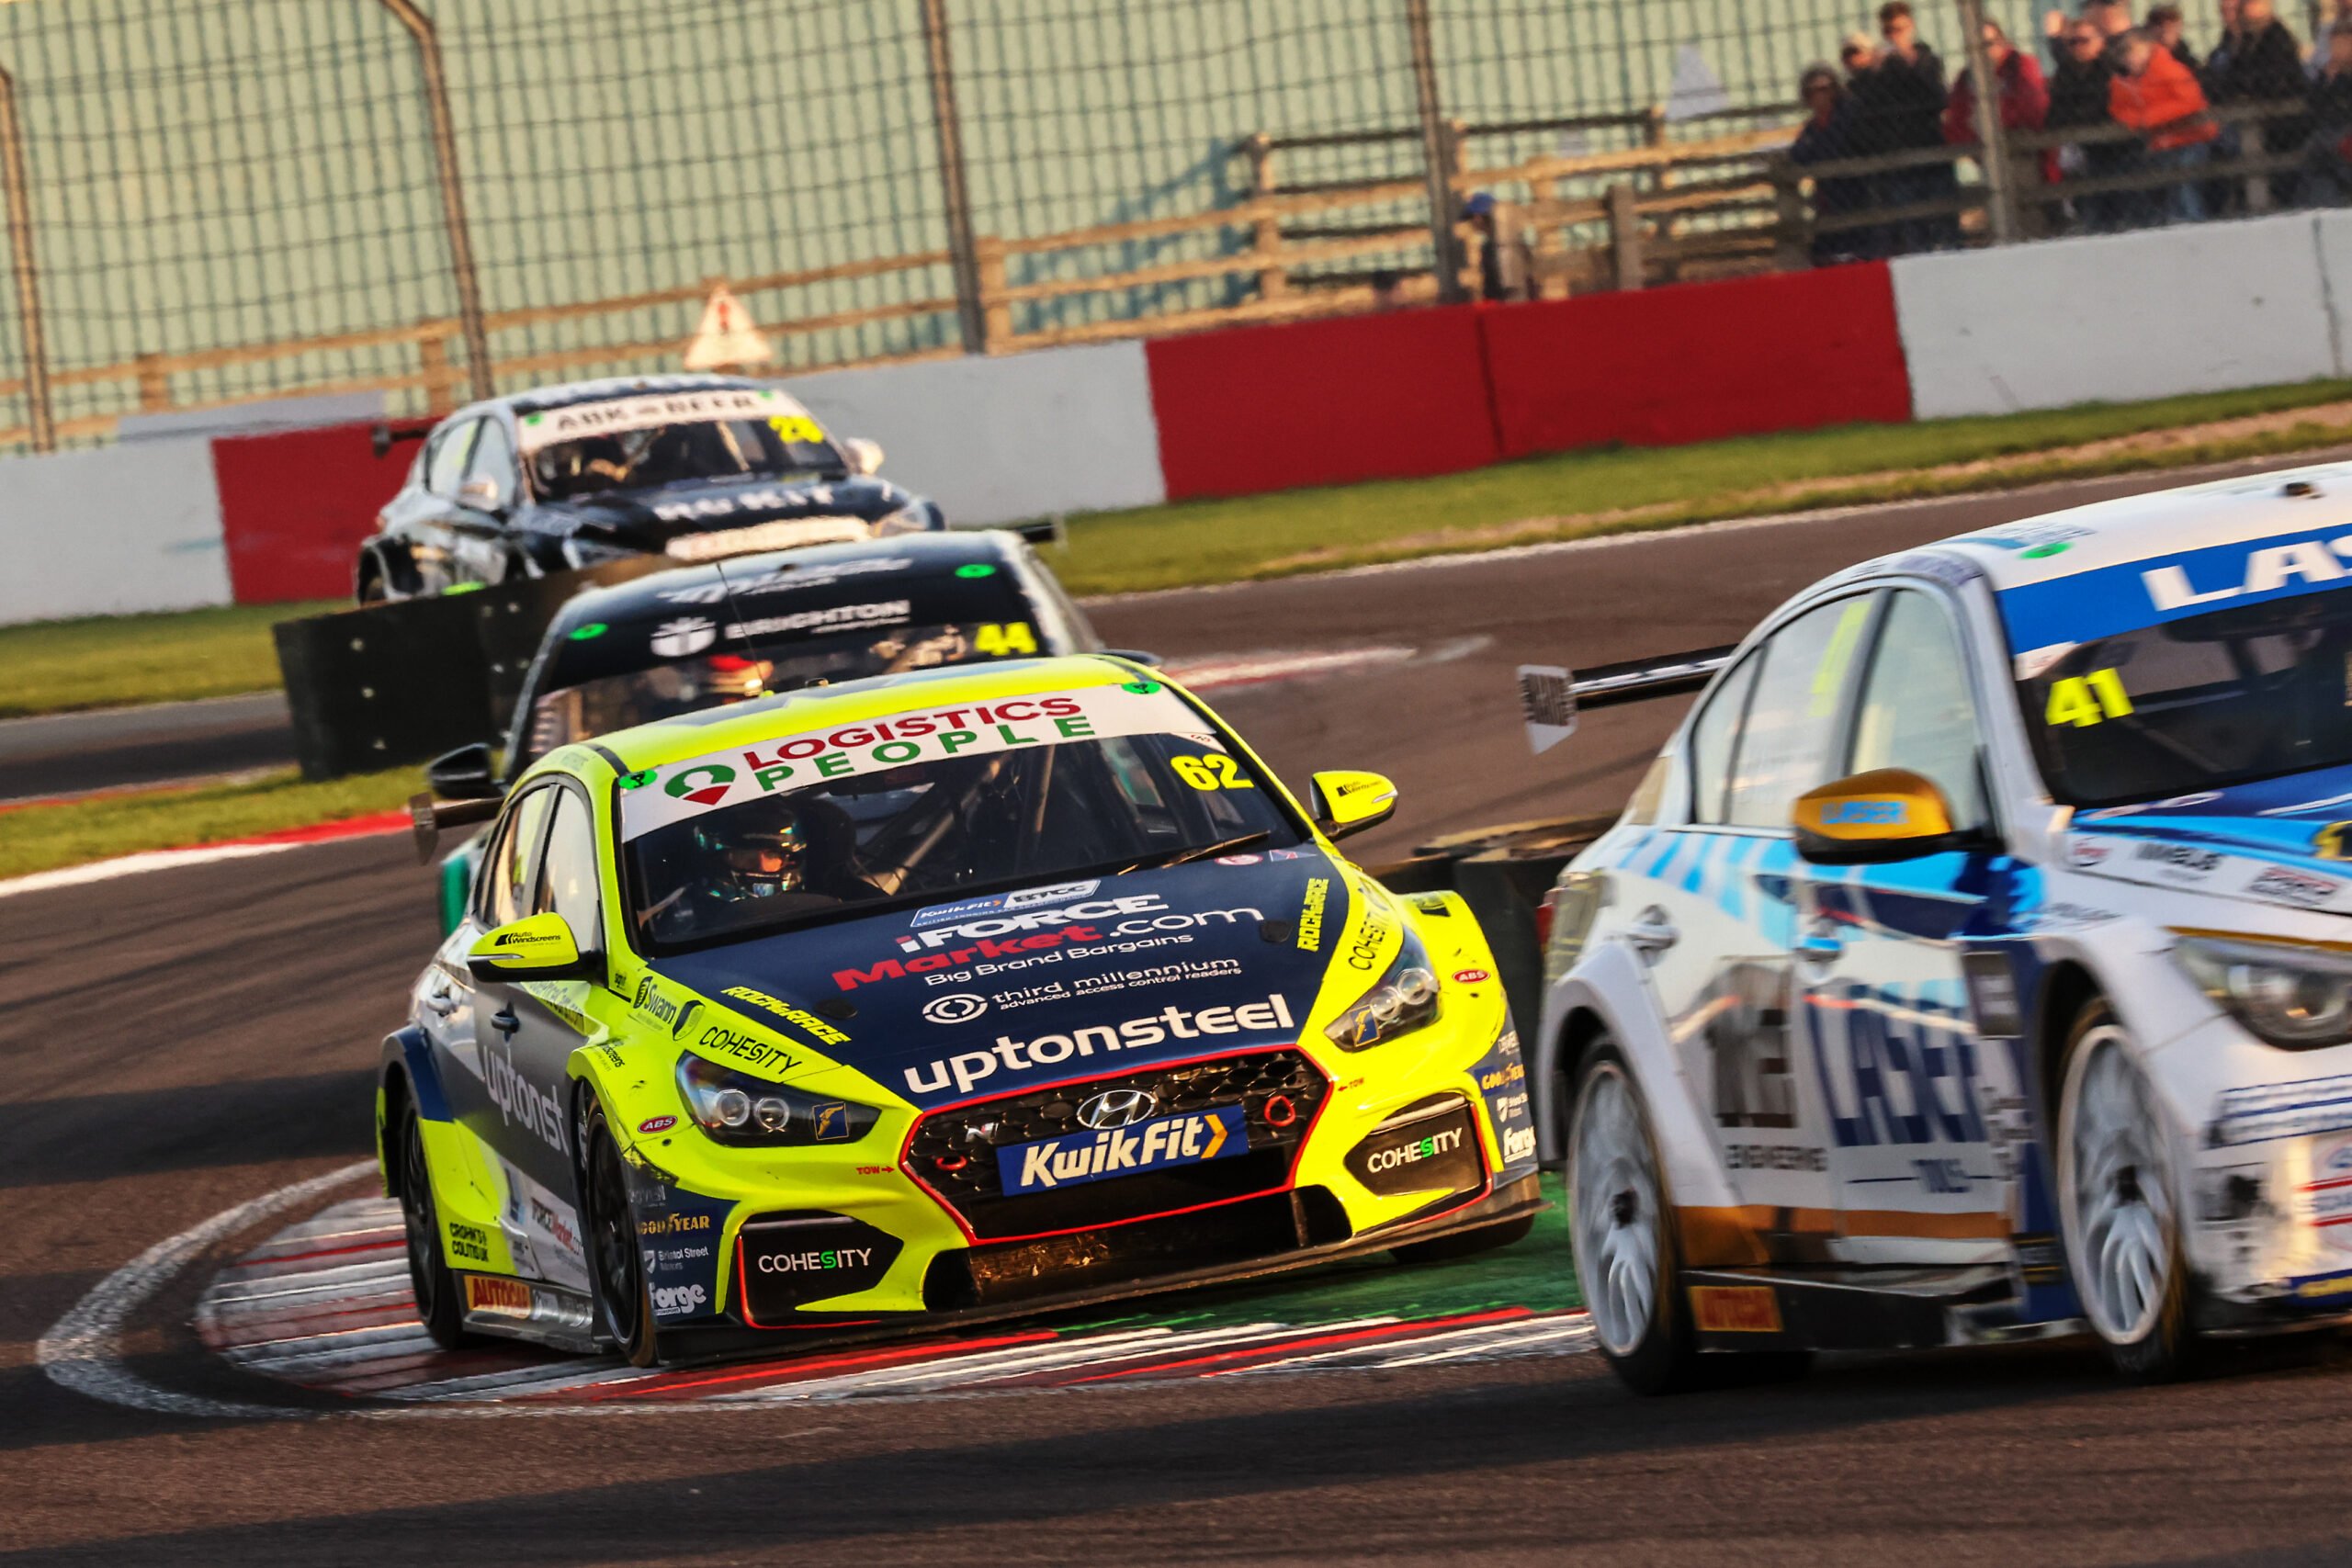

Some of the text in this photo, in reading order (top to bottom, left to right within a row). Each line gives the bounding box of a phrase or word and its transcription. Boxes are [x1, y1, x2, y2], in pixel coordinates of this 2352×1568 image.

[975, 622, 1037, 656] 44
[2044, 667, 2134, 728] 41
[743, 697, 1082, 770] LOGISTICS
[754, 715, 1095, 792] PEOPLE
[1170, 753, 1254, 791] 62
[895, 893, 1170, 953] iFORCE
[925, 932, 1194, 986] Big Brand Bargains
[992, 958, 1239, 1004] third millennium
[644, 984, 677, 1024] Swann
[1000, 967, 1242, 1010] advanced access control readers
[699, 1026, 802, 1075] COHESITY
[903, 994, 1295, 1094] uptonsteel
[644, 1119, 673, 1131] ABS
[856, 1167, 880, 1175] TOW
[1367, 1127, 1464, 1174] COHESITY
[684, 1247, 709, 1258] Street
[758, 1248, 872, 1273] COHESITY
